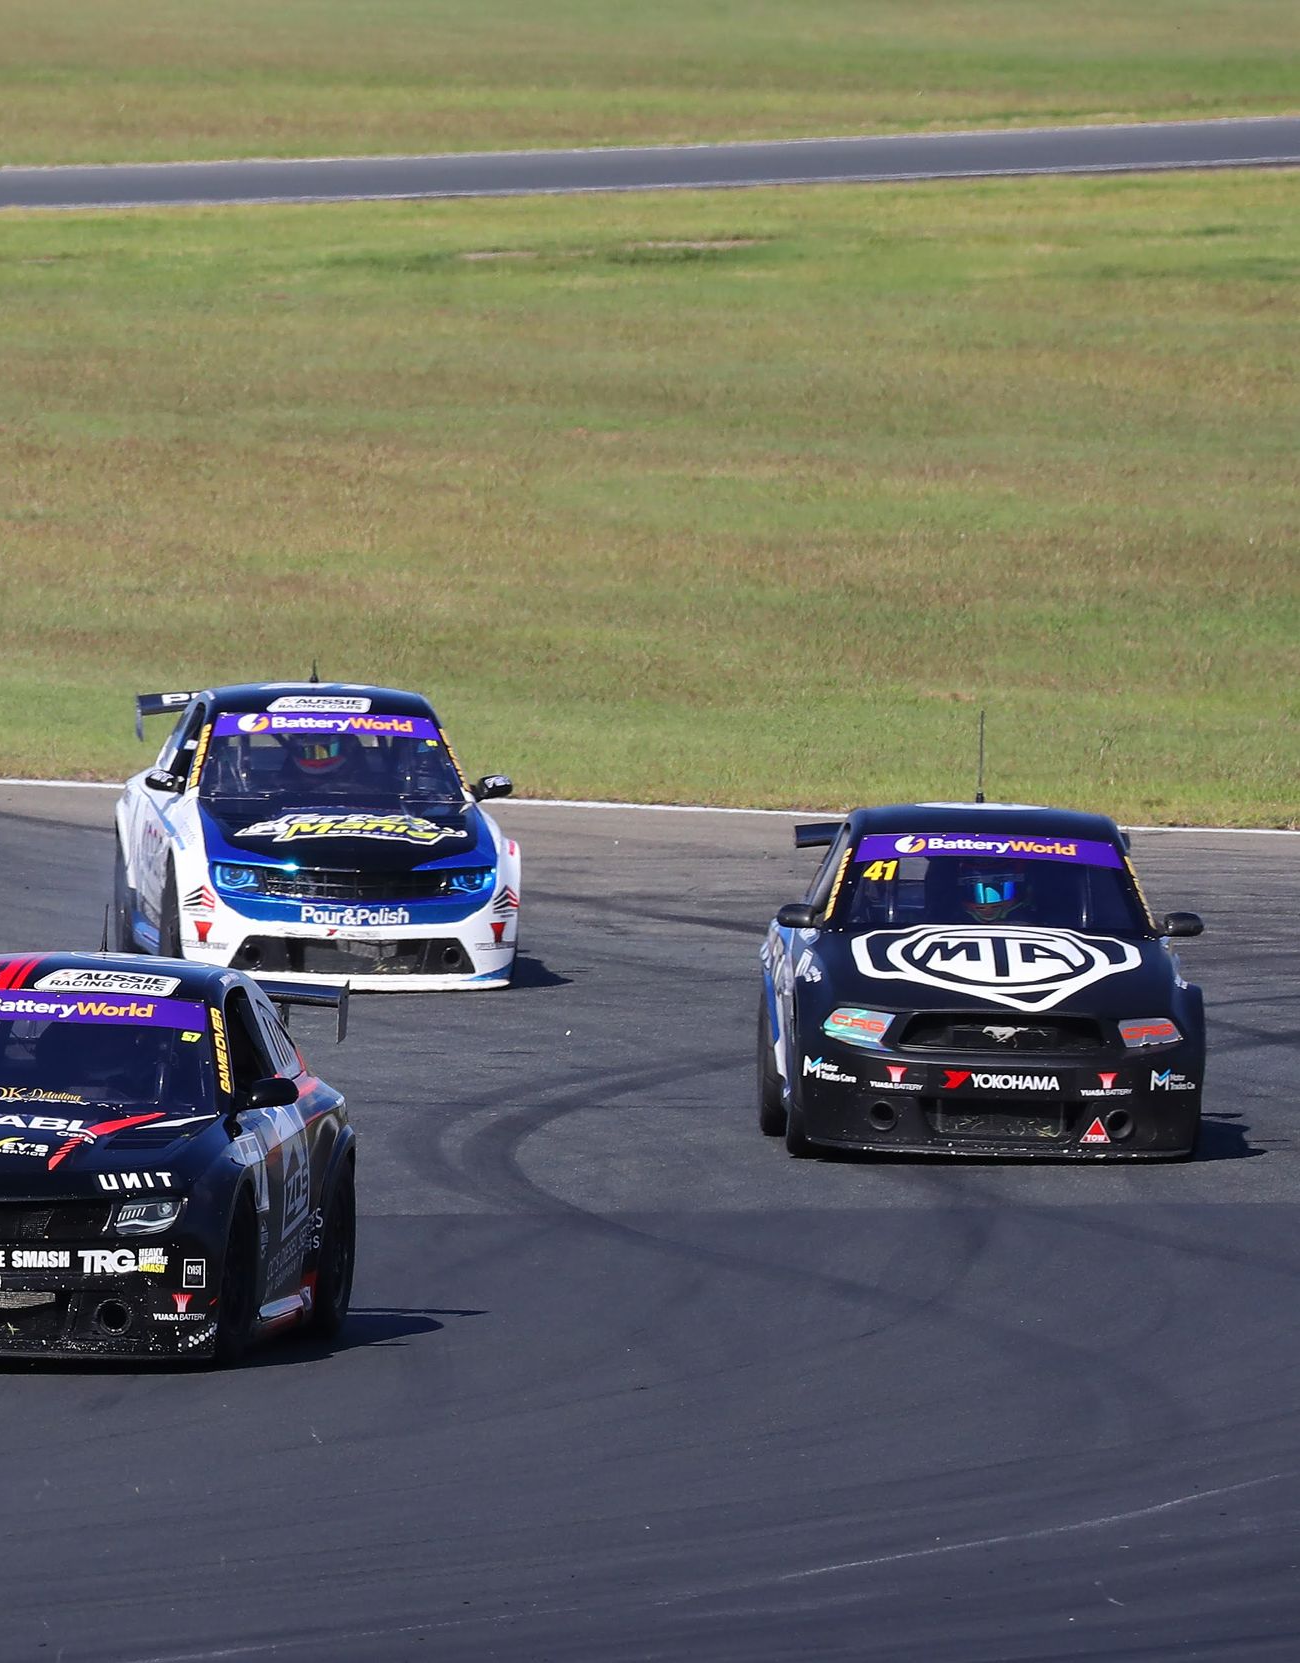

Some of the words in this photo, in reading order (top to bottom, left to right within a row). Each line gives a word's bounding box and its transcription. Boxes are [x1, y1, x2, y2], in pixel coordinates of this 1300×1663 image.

[271, 717, 413, 732] BatteryWorld
[928, 838, 1077, 856] BatteryWorld
[862, 860, 898, 881] 41
[300, 905, 410, 925] Pour&Polish
[49, 979, 116, 989] RACING
[119, 983, 165, 992] CARS
[74, 972, 169, 986] AUSSIE
[870, 1081, 894, 1089] YUASA
[971, 1073, 1060, 1090] YOKOHAMA
[55, 1131, 95, 1145] Corp
[11, 1250, 70, 1268] SMASH
[138, 1247, 164, 1258] HEAVY
[138, 1255, 169, 1266] VEHICLE
[137, 1264, 166, 1274] SMASH
[153, 1312, 178, 1321] YUASA
[179, 1313, 206, 1321] BATTERY
